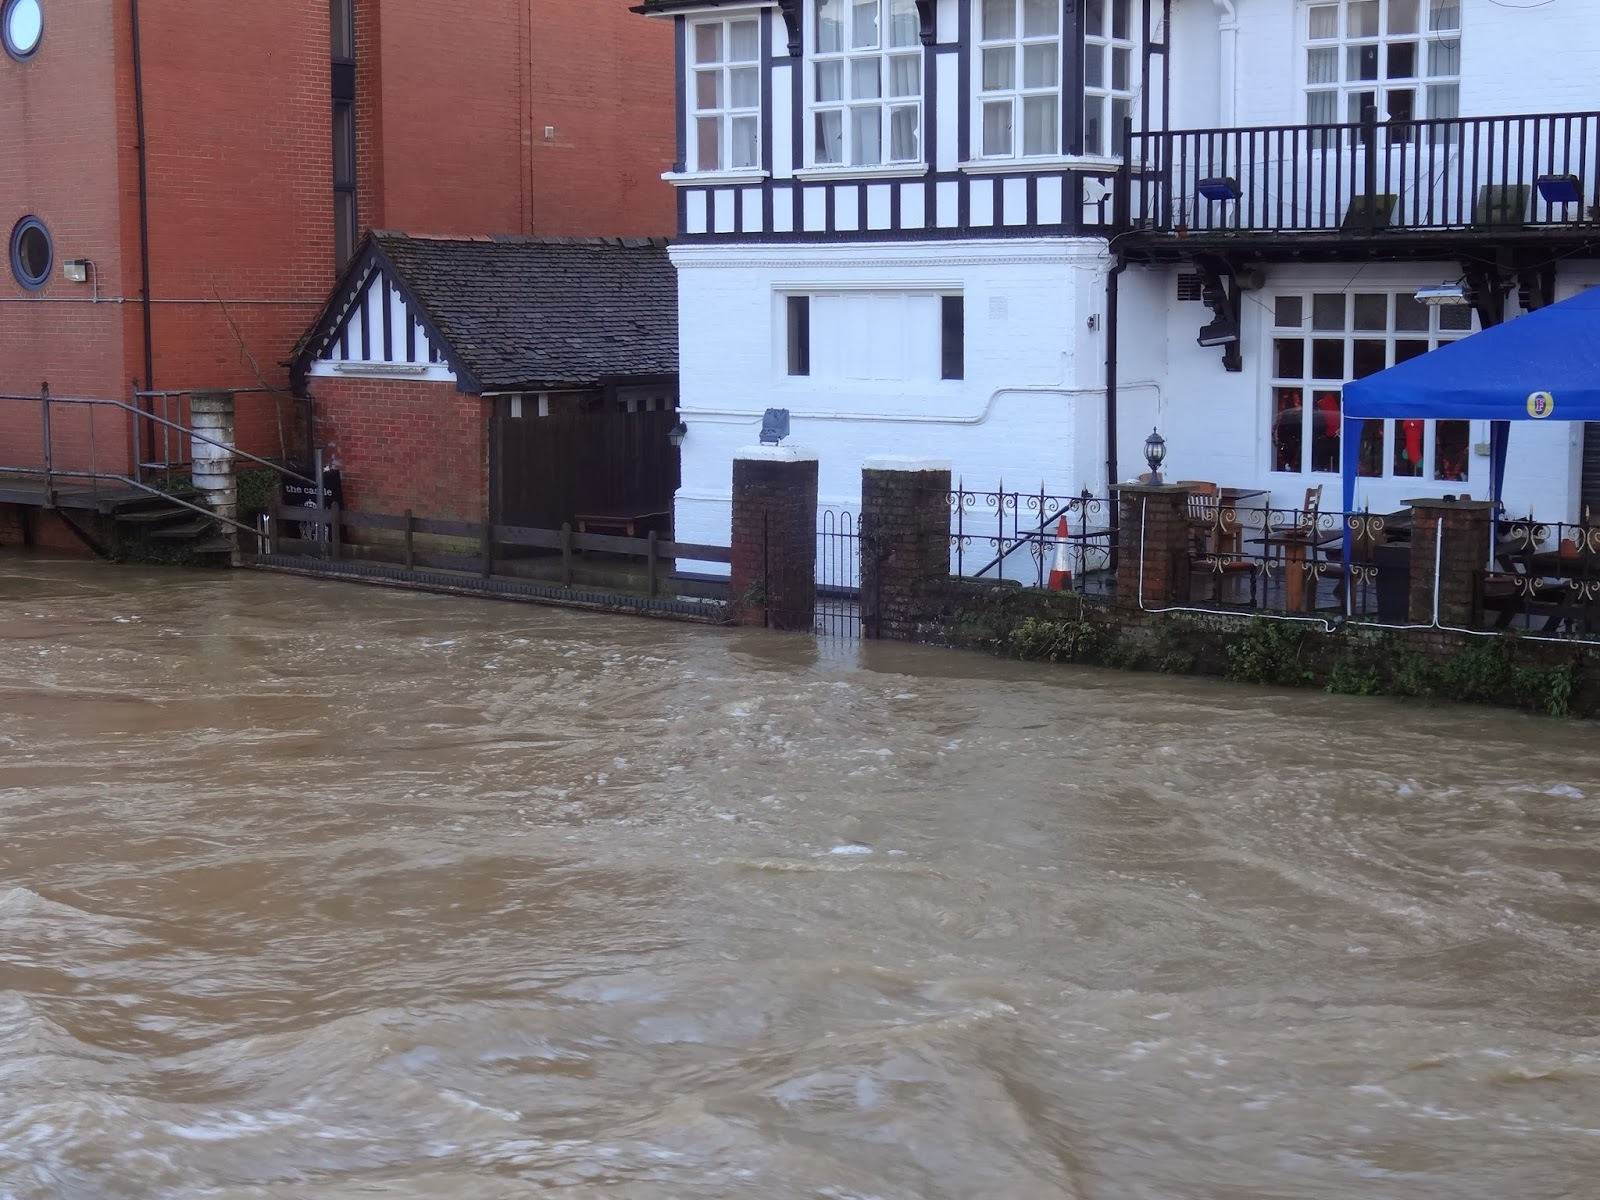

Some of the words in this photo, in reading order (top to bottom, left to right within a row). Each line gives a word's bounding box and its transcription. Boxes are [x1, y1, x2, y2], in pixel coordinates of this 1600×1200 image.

[1535, 398, 1545, 411] F
[285, 485, 302, 493] the
[304, 487, 332, 496] casle
